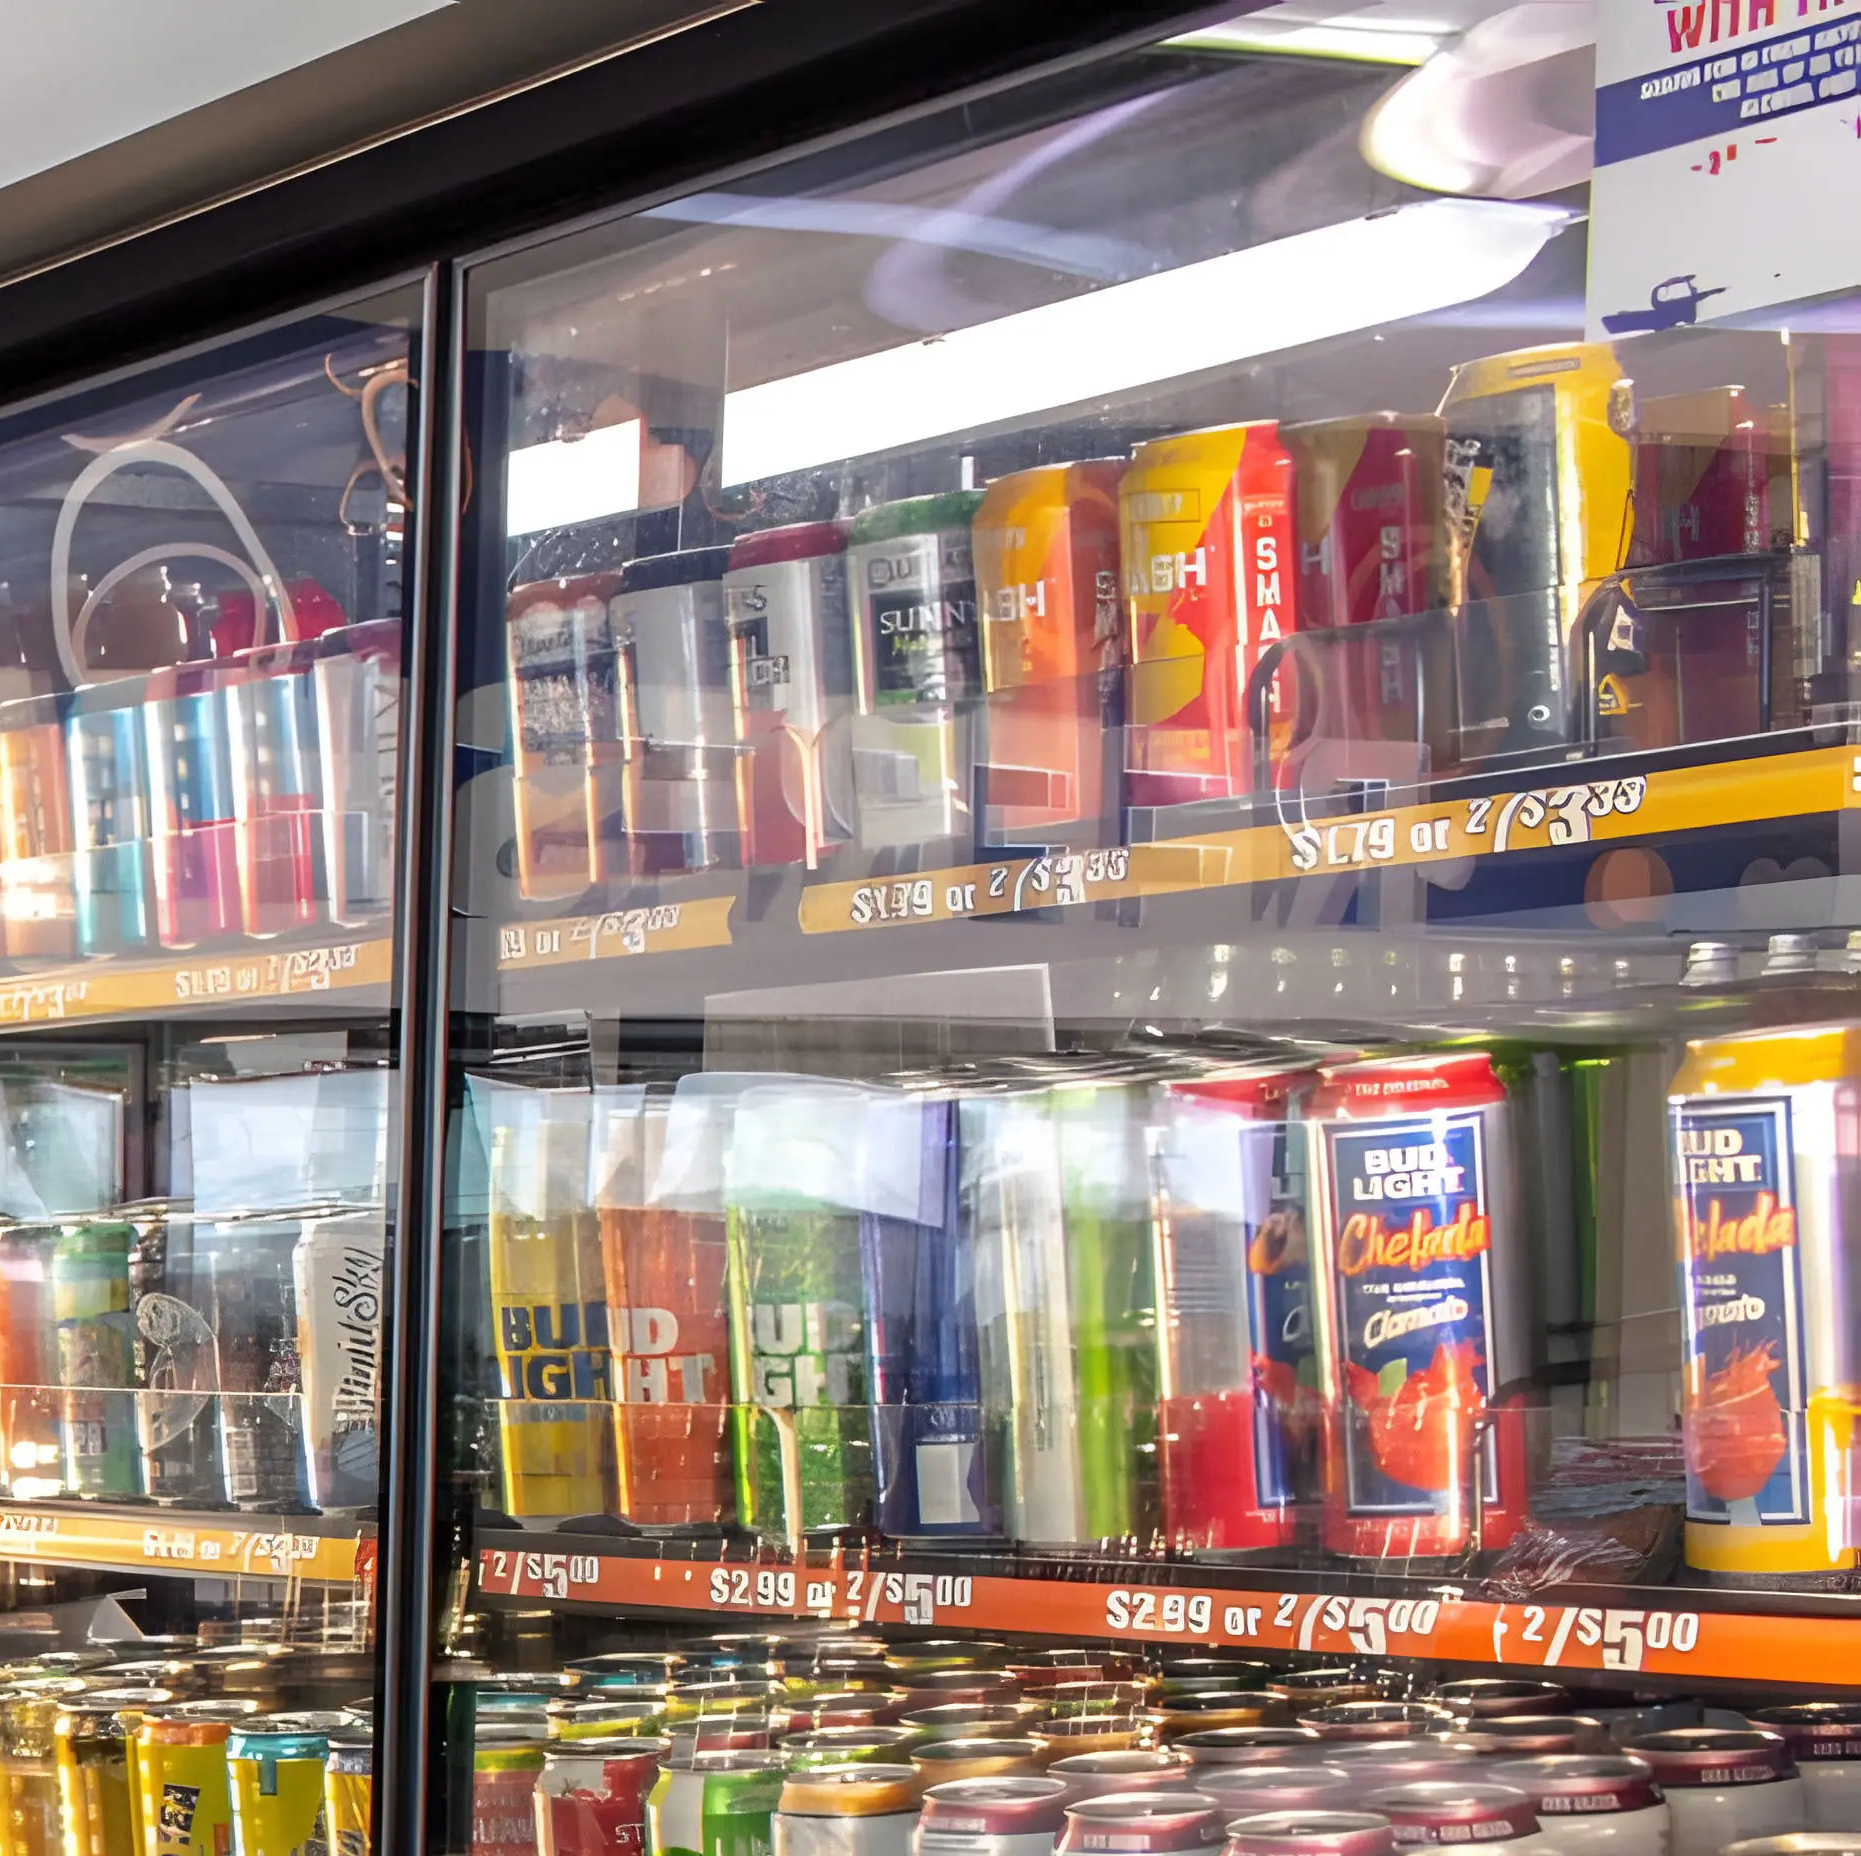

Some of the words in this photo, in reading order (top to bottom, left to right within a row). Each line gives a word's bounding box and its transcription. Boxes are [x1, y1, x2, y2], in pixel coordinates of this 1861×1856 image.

[1363, 1143, 1451, 1175] BUD
[1353, 1165, 1466, 1201] LIGHT
[1223, 1606, 1263, 1637] or
